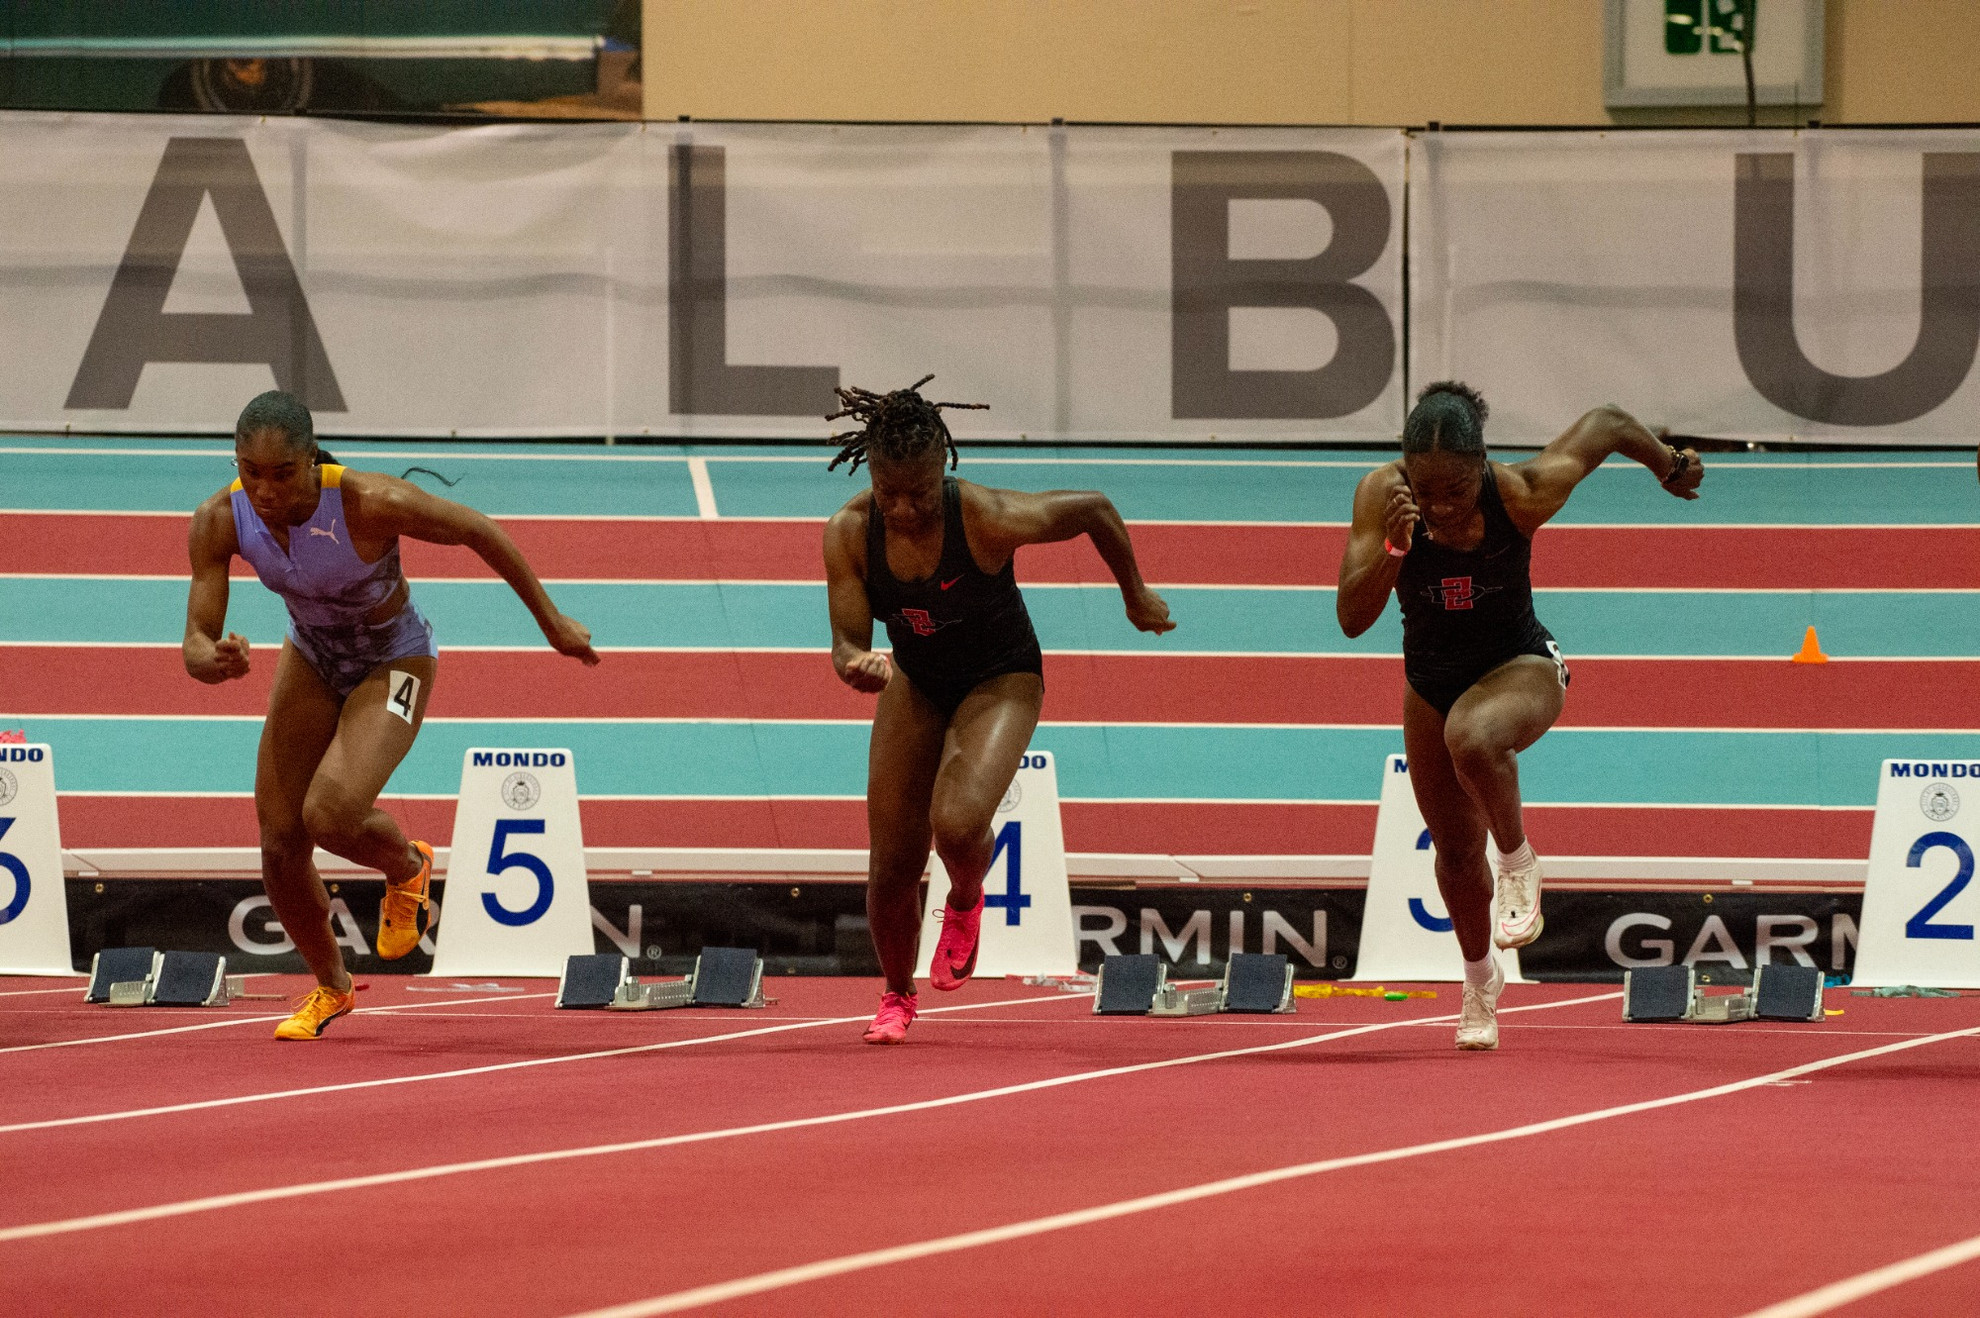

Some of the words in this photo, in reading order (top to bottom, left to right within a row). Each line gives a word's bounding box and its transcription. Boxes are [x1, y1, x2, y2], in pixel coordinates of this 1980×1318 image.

[394, 676, 411, 717] 4
[473, 752, 566, 767] MONDO
[1890, 763, 1980, 778] MONDO
[481, 819, 555, 926] 5
[983, 821, 1032, 926] 4
[1905, 831, 1975, 940] 2
[1071, 905, 1327, 968] RMIN
